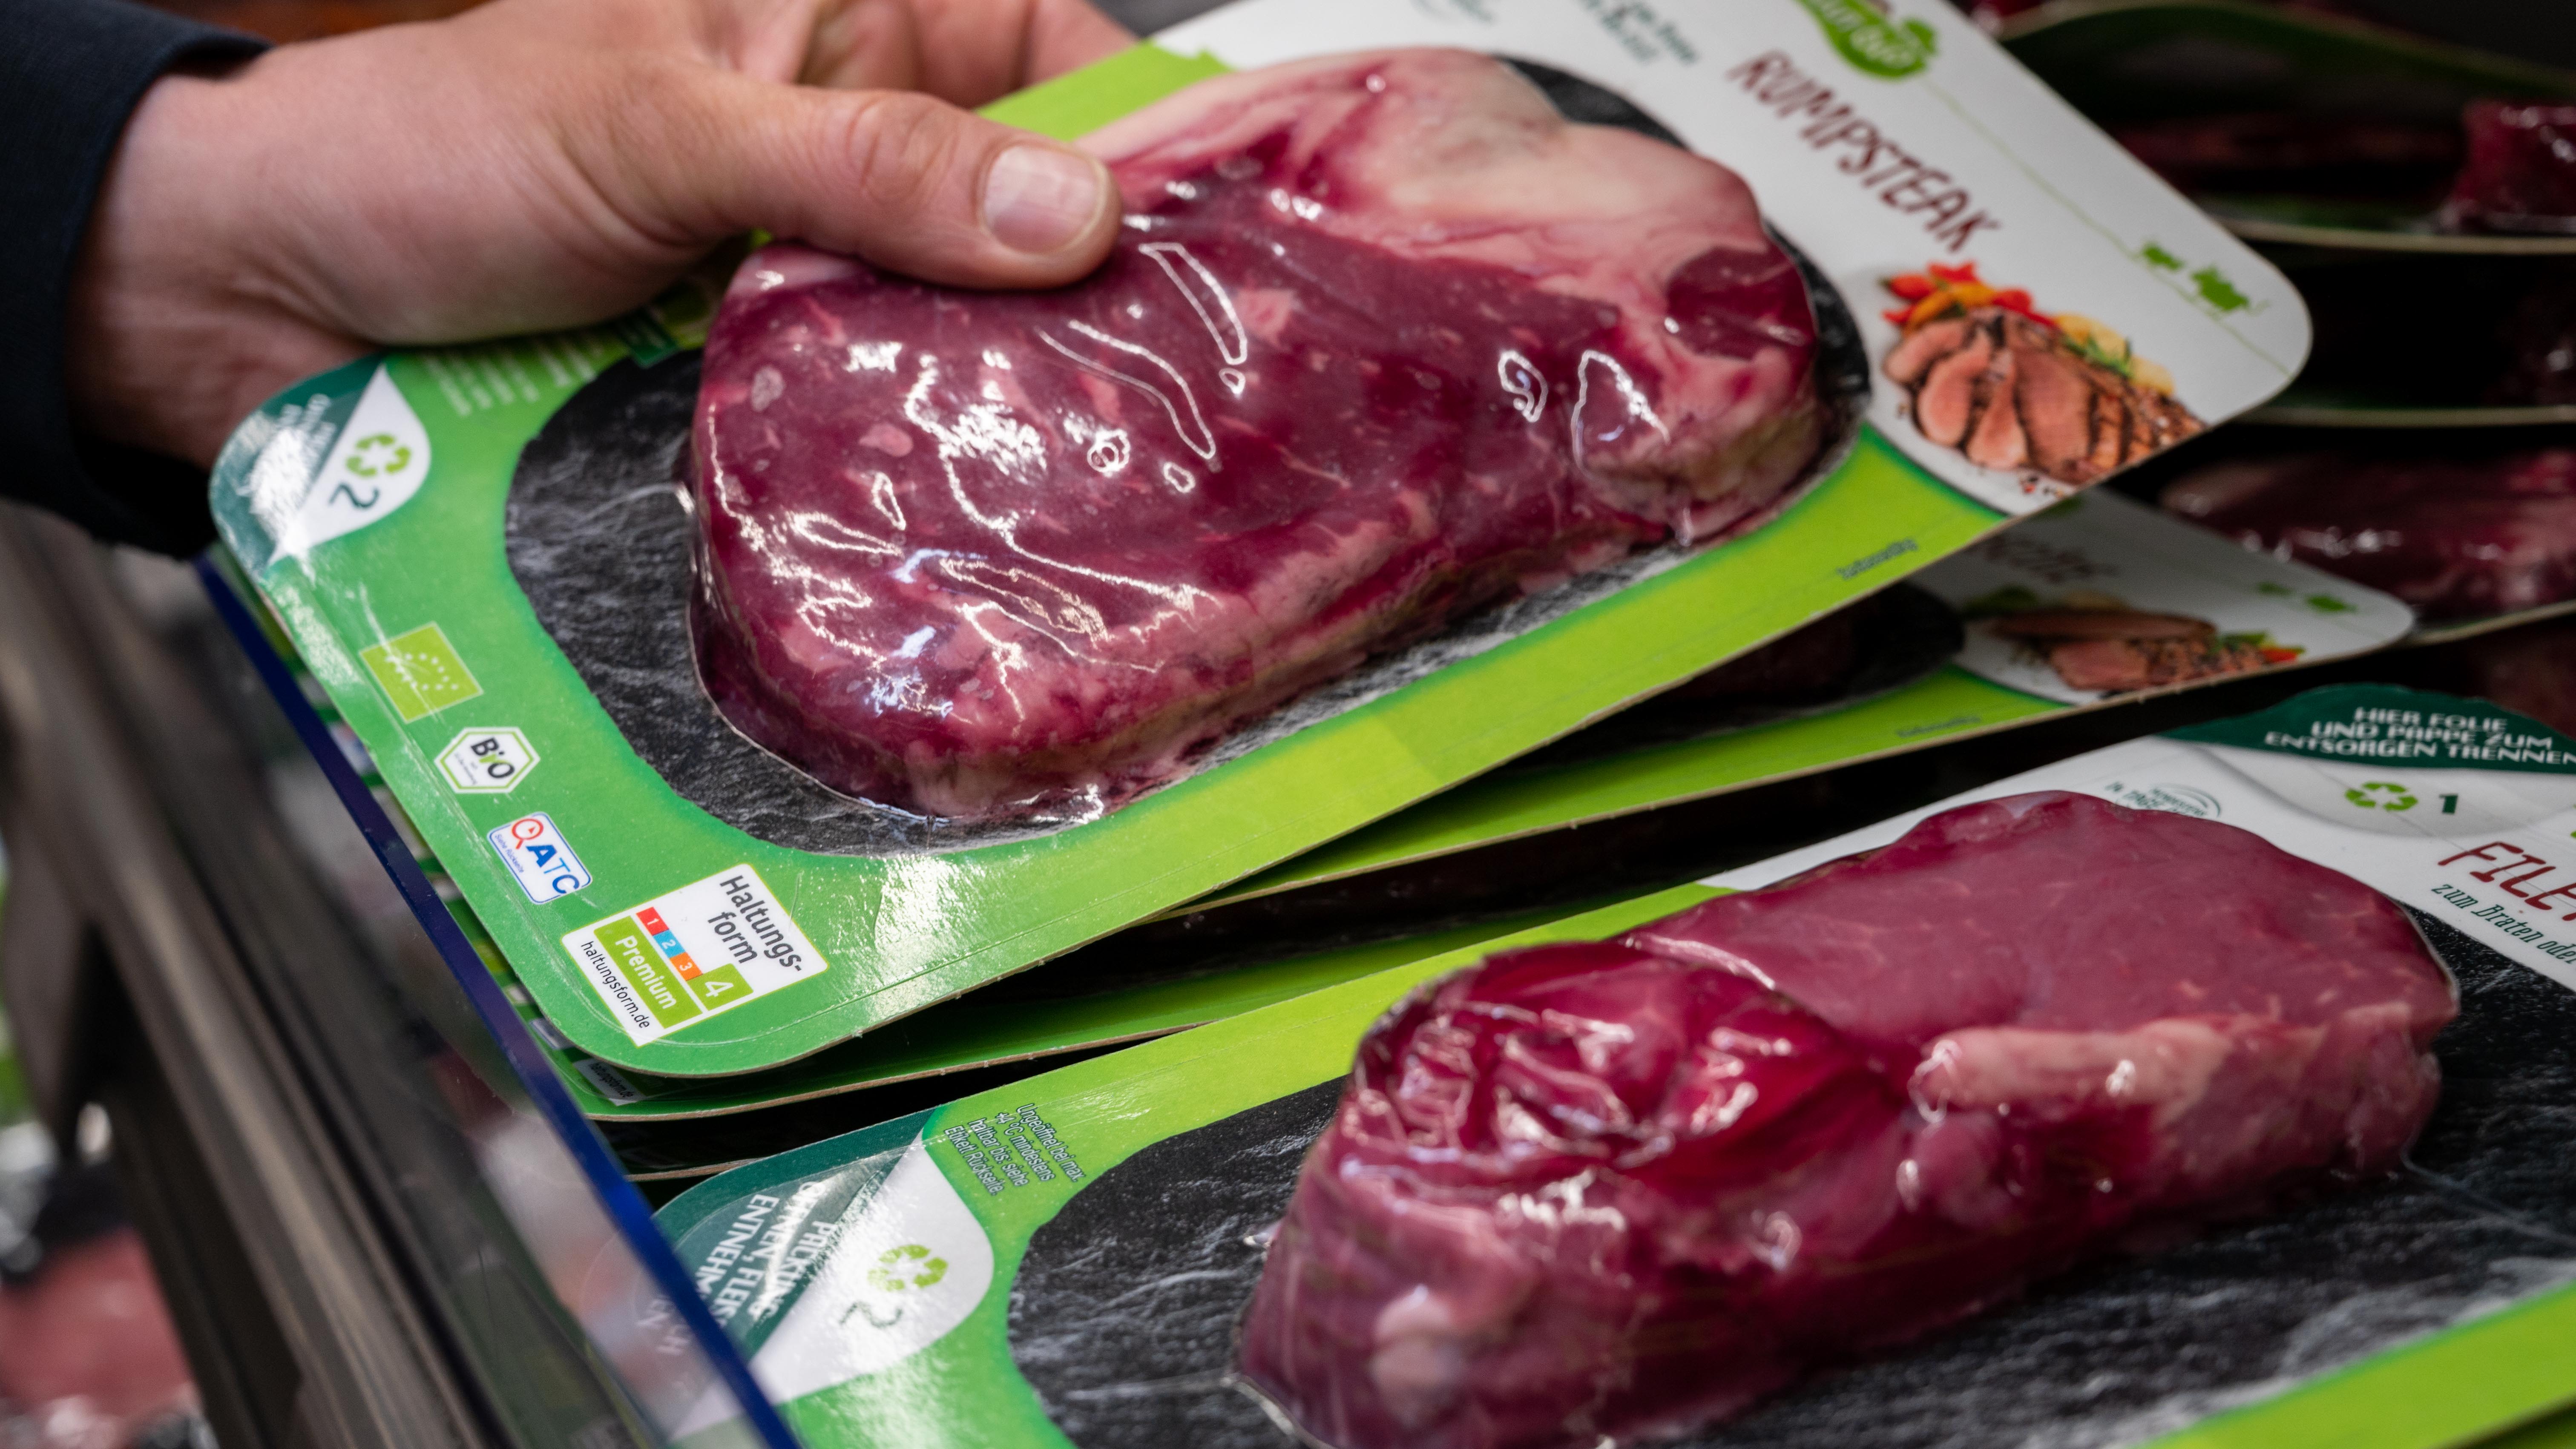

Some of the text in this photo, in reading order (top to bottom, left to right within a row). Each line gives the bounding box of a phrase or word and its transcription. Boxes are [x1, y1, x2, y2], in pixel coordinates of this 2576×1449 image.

[1725, 49, 2001, 252] RUMPSTEAK
[328, 480, 380, 509] 2
[2311, 721, 2553, 750] UND PAPPE ZUM
[2354, 706, 2507, 732] HIER FOLIE
[2264, 731, 2438, 758] ENTSORGEN
[2439, 794, 2458, 814] 1
[2438, 841, 2576, 921] FILE
[646, 917, 660, 926] 1
[707, 911, 758, 964] form
[719, 875, 802, 972] Haltungs-
[2431, 884, 2478, 909] zum
[2470, 904, 2544, 943] Braten
[661, 939, 676, 950] 2
[679, 961, 693, 972] 3
[581, 940, 650, 1029] haltungsform.de
[615, 935, 677, 1010] Premium
[704, 981, 734, 998] 4
[944, 1125, 978, 1154] Etikett
[967, 1117, 1000, 1147] haltbar
[1001, 1163, 1029, 1187] siehe
[1009, 1135, 1055, 1182] mindestens
[1016, 1103, 1087, 1182] Ungeöffnet bei max.
[695, 1193, 780, 1300] ENTNEHM
[709, 1267, 765, 1327] FLEIS
